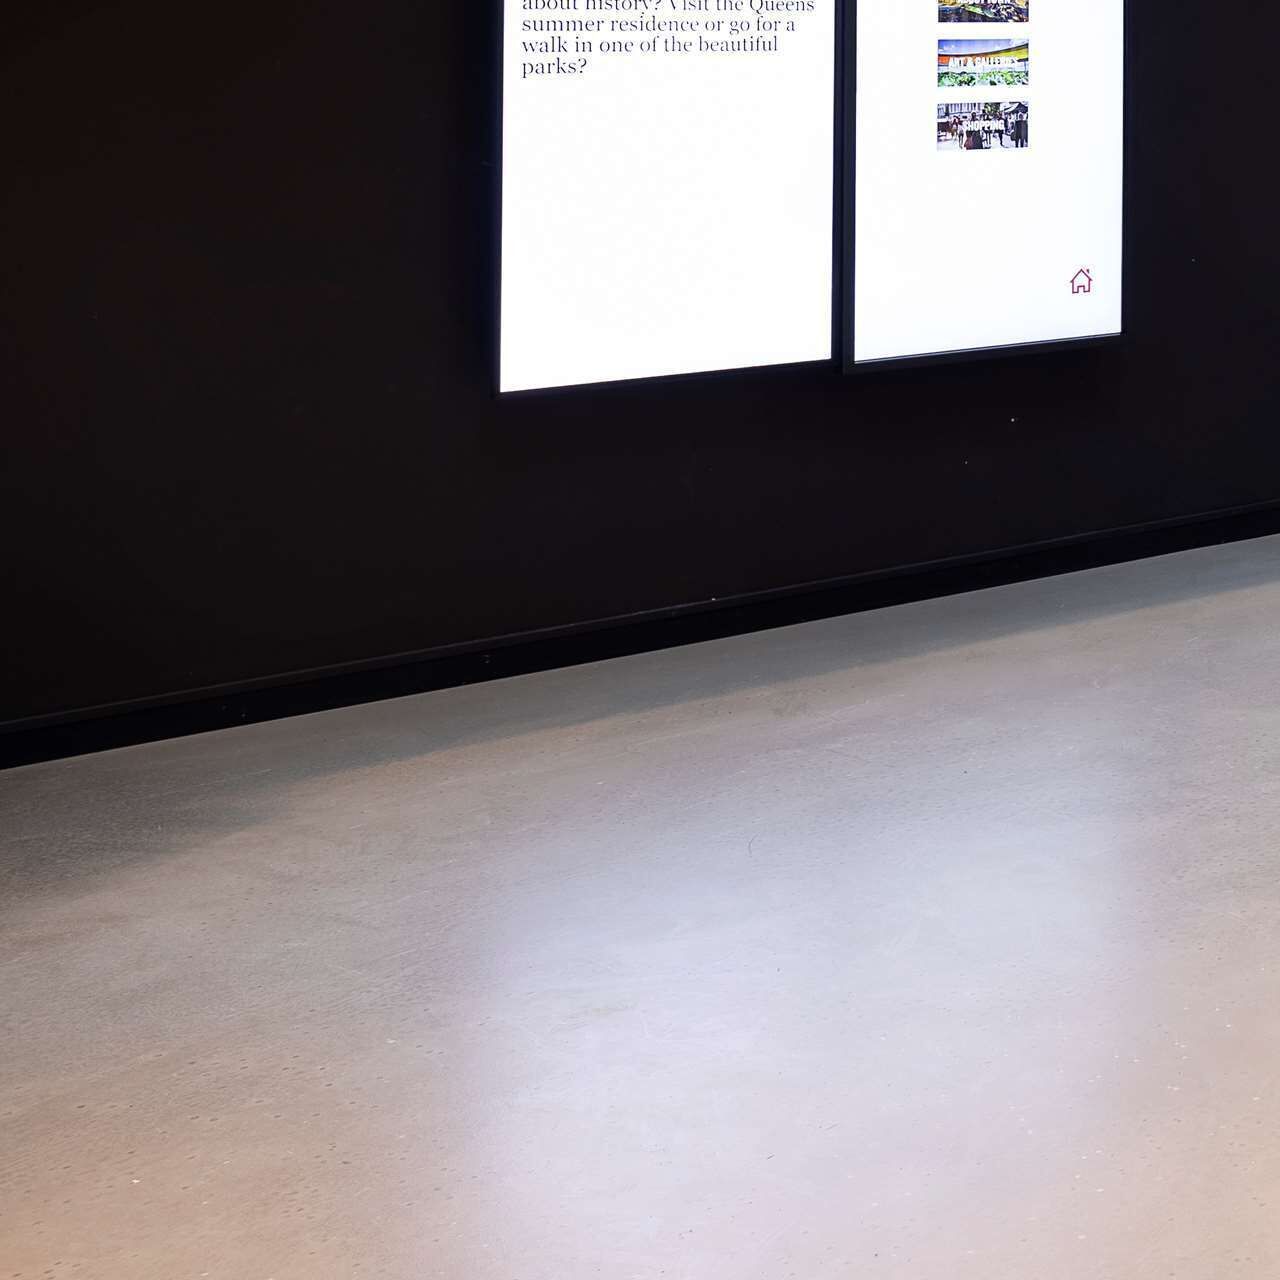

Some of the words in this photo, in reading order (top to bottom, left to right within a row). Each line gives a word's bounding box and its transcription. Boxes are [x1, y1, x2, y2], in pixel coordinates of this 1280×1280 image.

[521, 19, 605, 32] summer
[610, 15, 699, 32] residence
[705, 21, 725, 32] or
[729, 21, 750, 36] go
[756, 15, 782, 32] for
[786, 21, 796, 32] a
[522, 35, 569, 53] walk
[575, 35, 593, 53] in
[599, 40, 635, 53] one
[639, 35, 661, 52] of
[664, 35, 693, 53] the
[699, 35, 778, 52] beautiful
[522, 56, 588, 79] parks?
[964, 120, 1005, 131] SHOPPING
